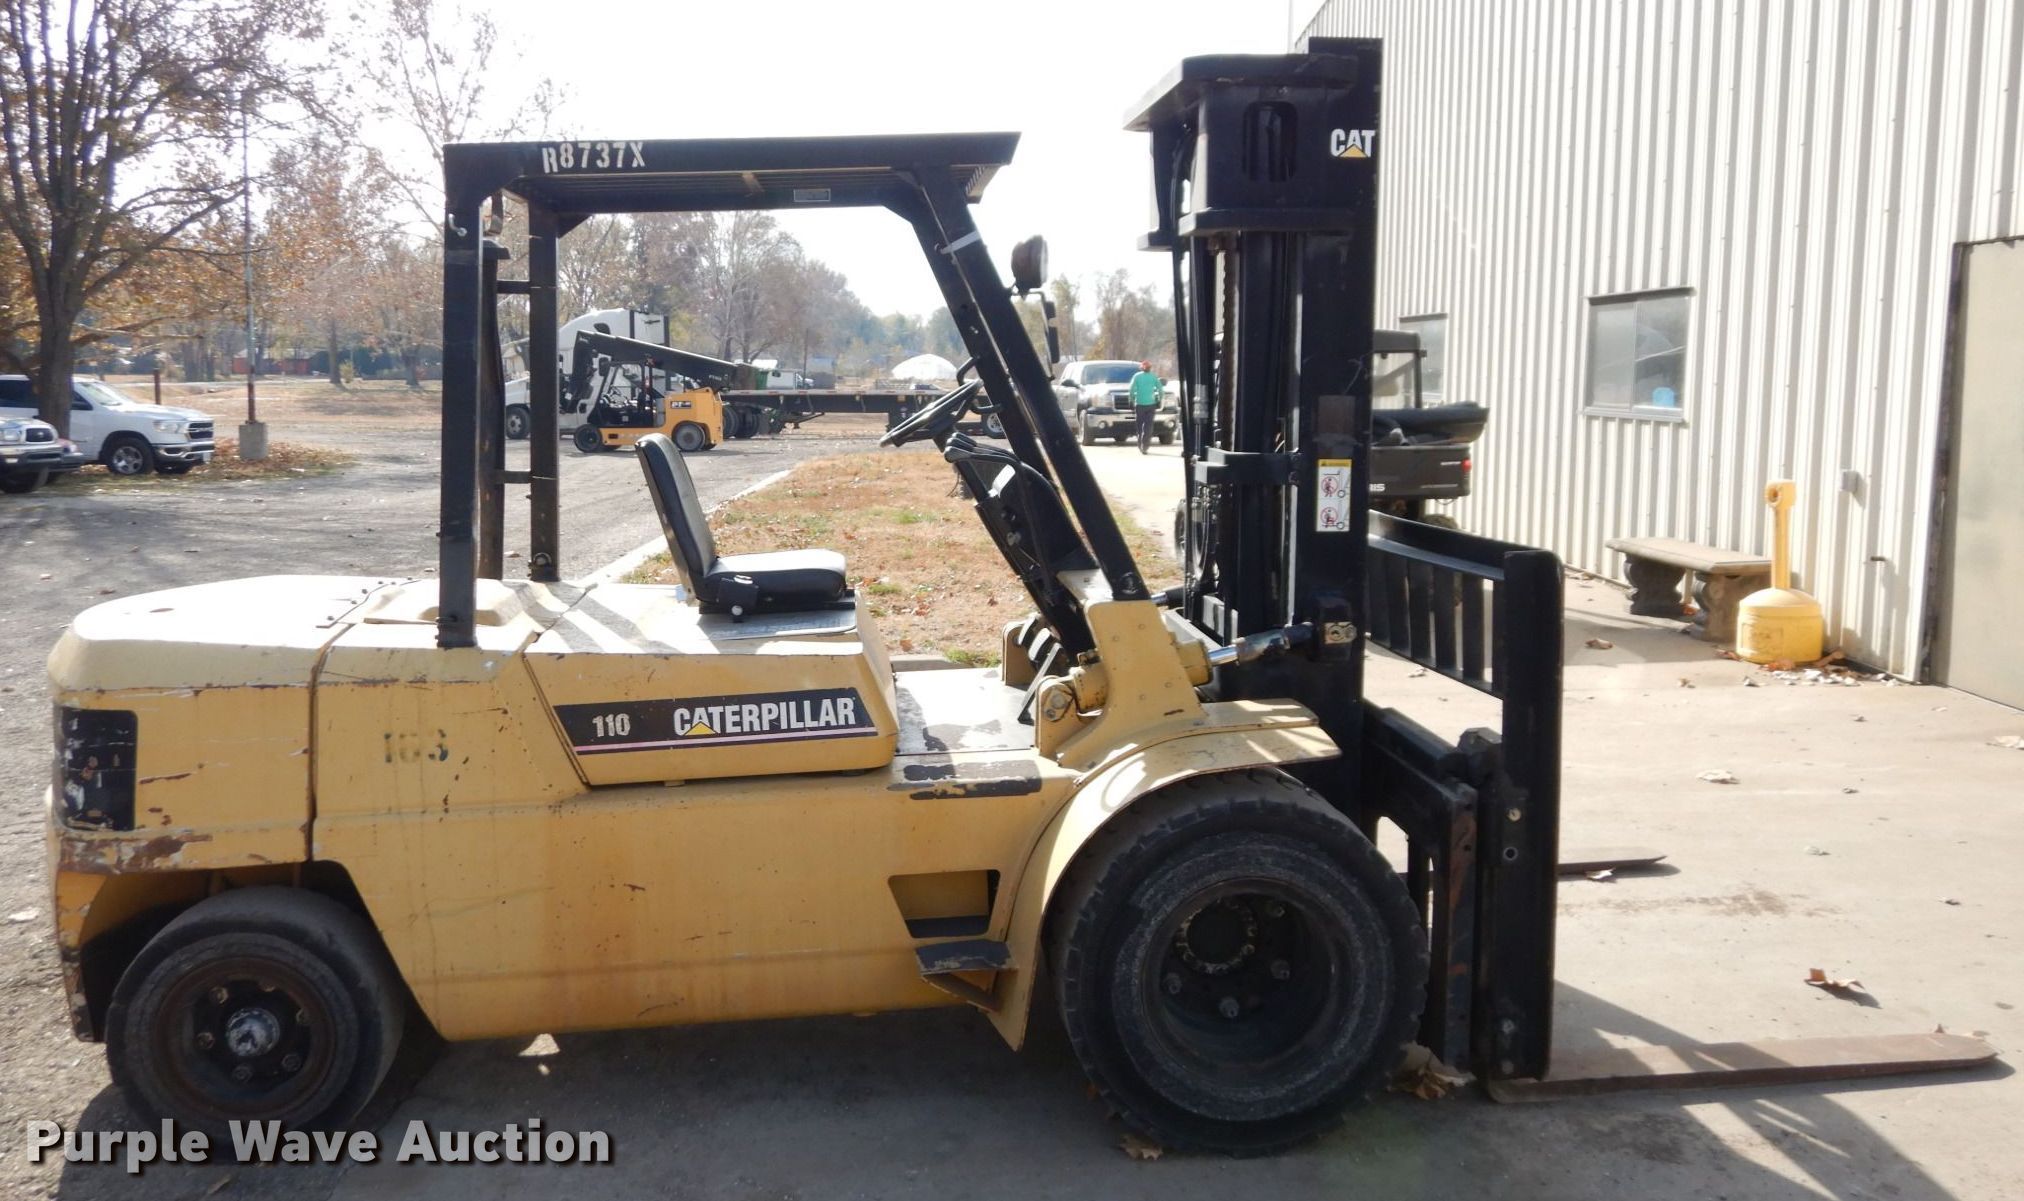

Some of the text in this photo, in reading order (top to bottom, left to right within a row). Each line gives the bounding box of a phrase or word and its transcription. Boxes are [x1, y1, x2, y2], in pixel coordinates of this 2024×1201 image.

[541, 142, 646, 174] R8737X
[1330, 128, 1376, 158] CAT
[592, 698, 856, 737] 110 CATERPILLAR
